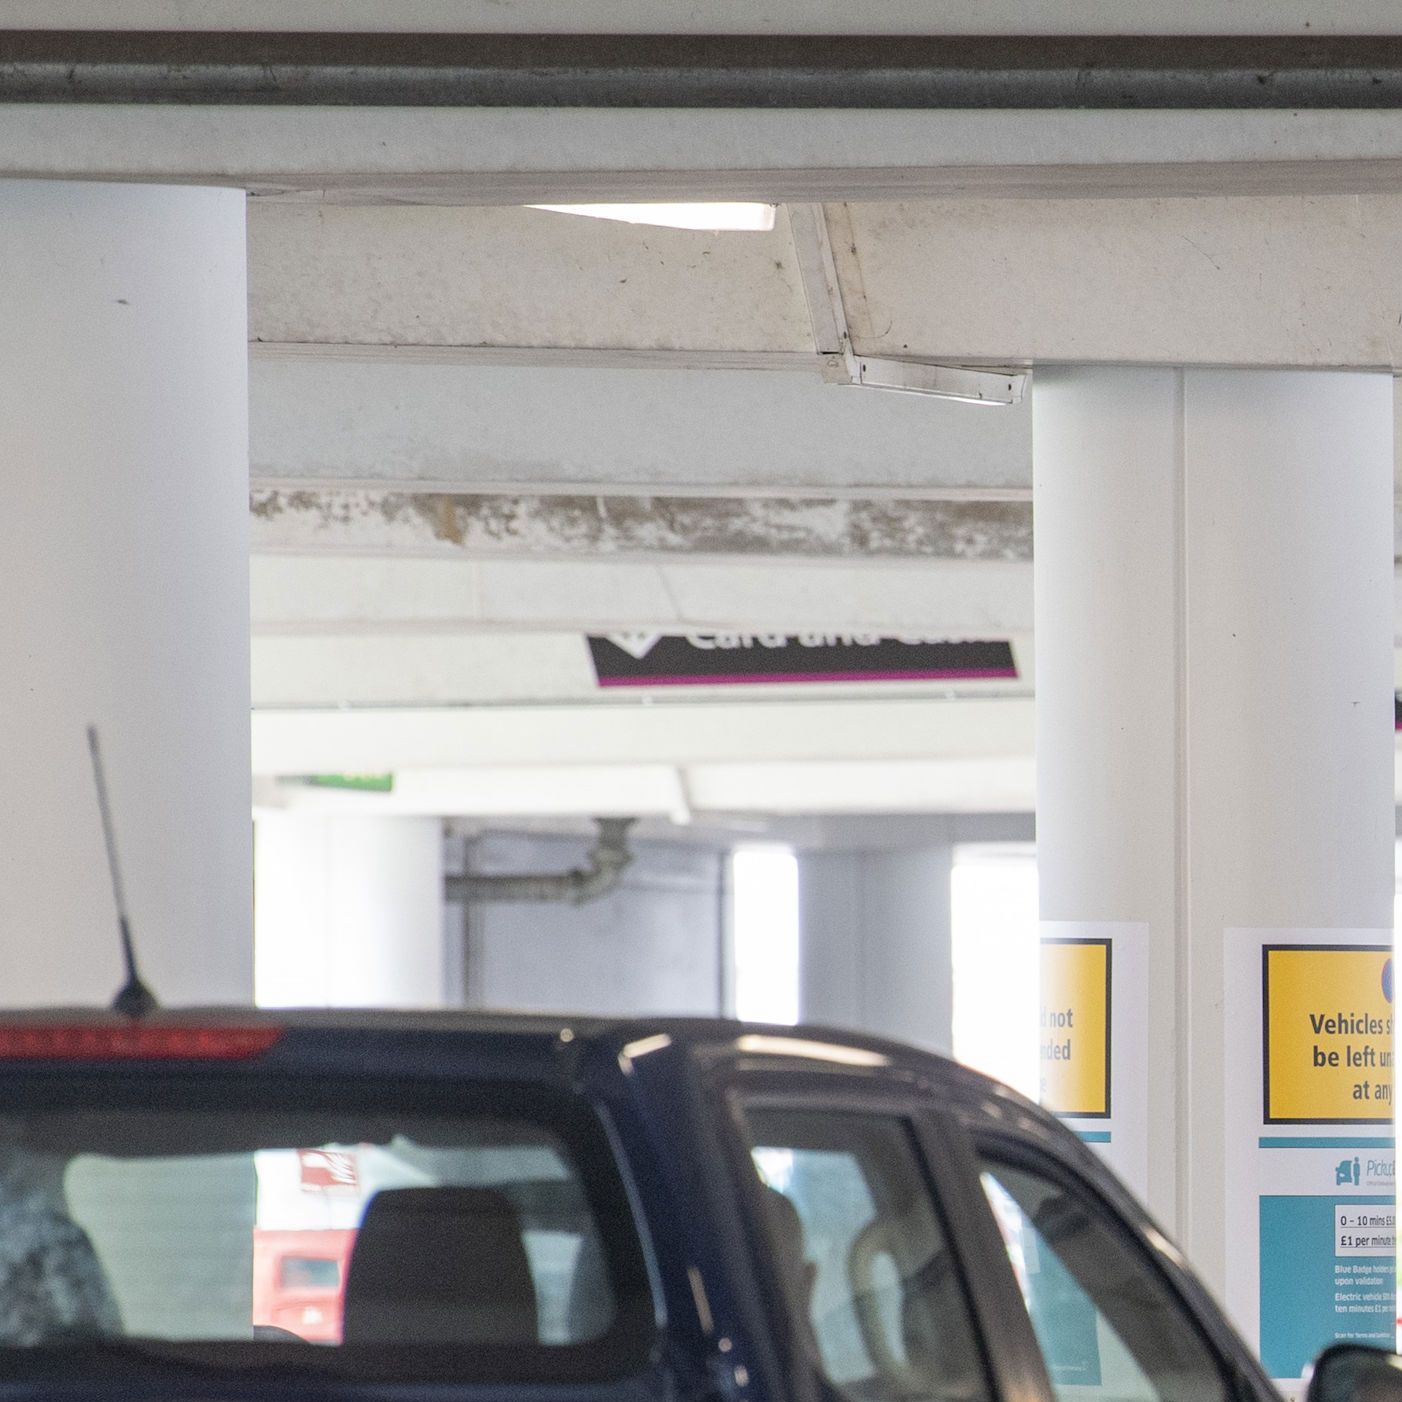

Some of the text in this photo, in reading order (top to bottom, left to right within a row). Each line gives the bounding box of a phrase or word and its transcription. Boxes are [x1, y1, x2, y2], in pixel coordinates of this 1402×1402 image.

[1310, 1013, 1384, 1034] Vehicles
[1313, 1045, 1340, 1067] be
[1347, 1045, 1376, 1067] left
[1352, 1080, 1370, 1100] at
[1357, 1215, 1368, 1226] 10
[1369, 1214, 1386, 1226] mins
[1340, 1236, 1353, 1246] £1
[1355, 1237, 1370, 1247] per
[1334, 1265, 1352, 1274] Blue
[1334, 1292, 1362, 1301] Electric
[1334, 1304, 1348, 1313] ten
